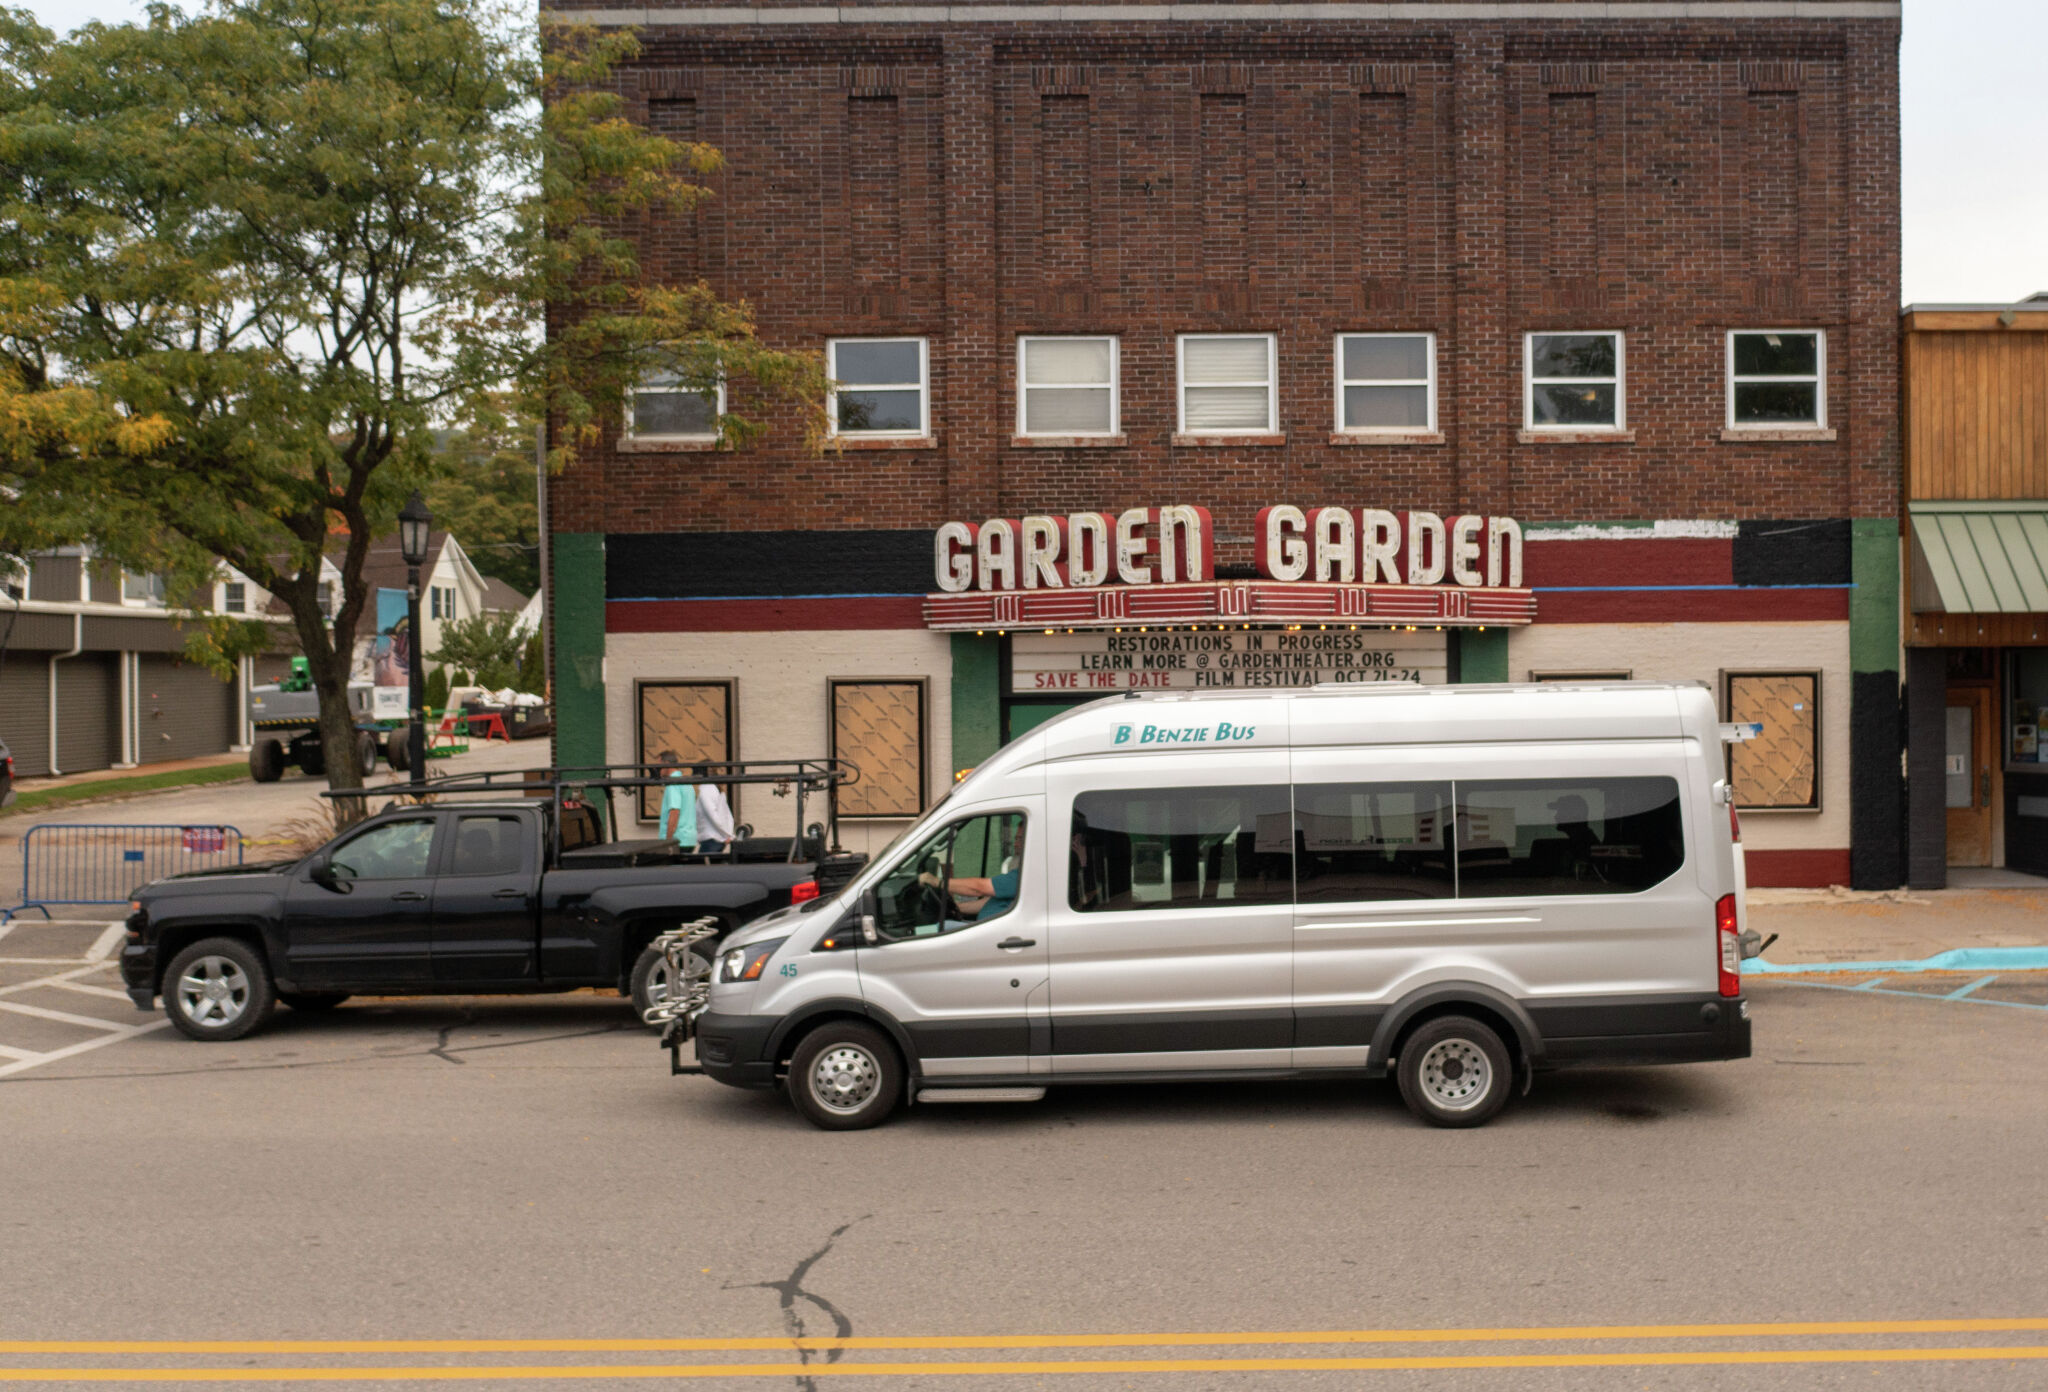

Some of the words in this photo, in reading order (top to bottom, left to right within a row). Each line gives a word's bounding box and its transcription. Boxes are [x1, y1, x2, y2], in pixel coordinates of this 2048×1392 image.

[935, 504, 1203, 592] GARDEN
[1267, 504, 1524, 588] GARDEN
[1108, 635, 1233, 652] RESTORATIONS
[1246, 636, 1263, 651] IN
[1278, 634, 1364, 650] PROGRESS
[1081, 654, 1133, 670] LEARN
[1143, 654, 1187, 669] MORE
[1196, 653, 1210, 669] @
[1219, 652, 1395, 668] GARDENTHEATER.ORG
[1035, 672, 1078, 688] SAVE
[1086, 672, 1117, 688] THE
[1129, 672, 1171, 687] DATE
[1196, 671, 1234, 687] FILM
[1244, 670, 1319, 686] FESTIVAL
[1335, 670, 1367, 683] OCT
[1373, 669, 1421, 684] 21-24
[1114, 725, 1132, 744] B
[780, 963, 798, 978] 45
